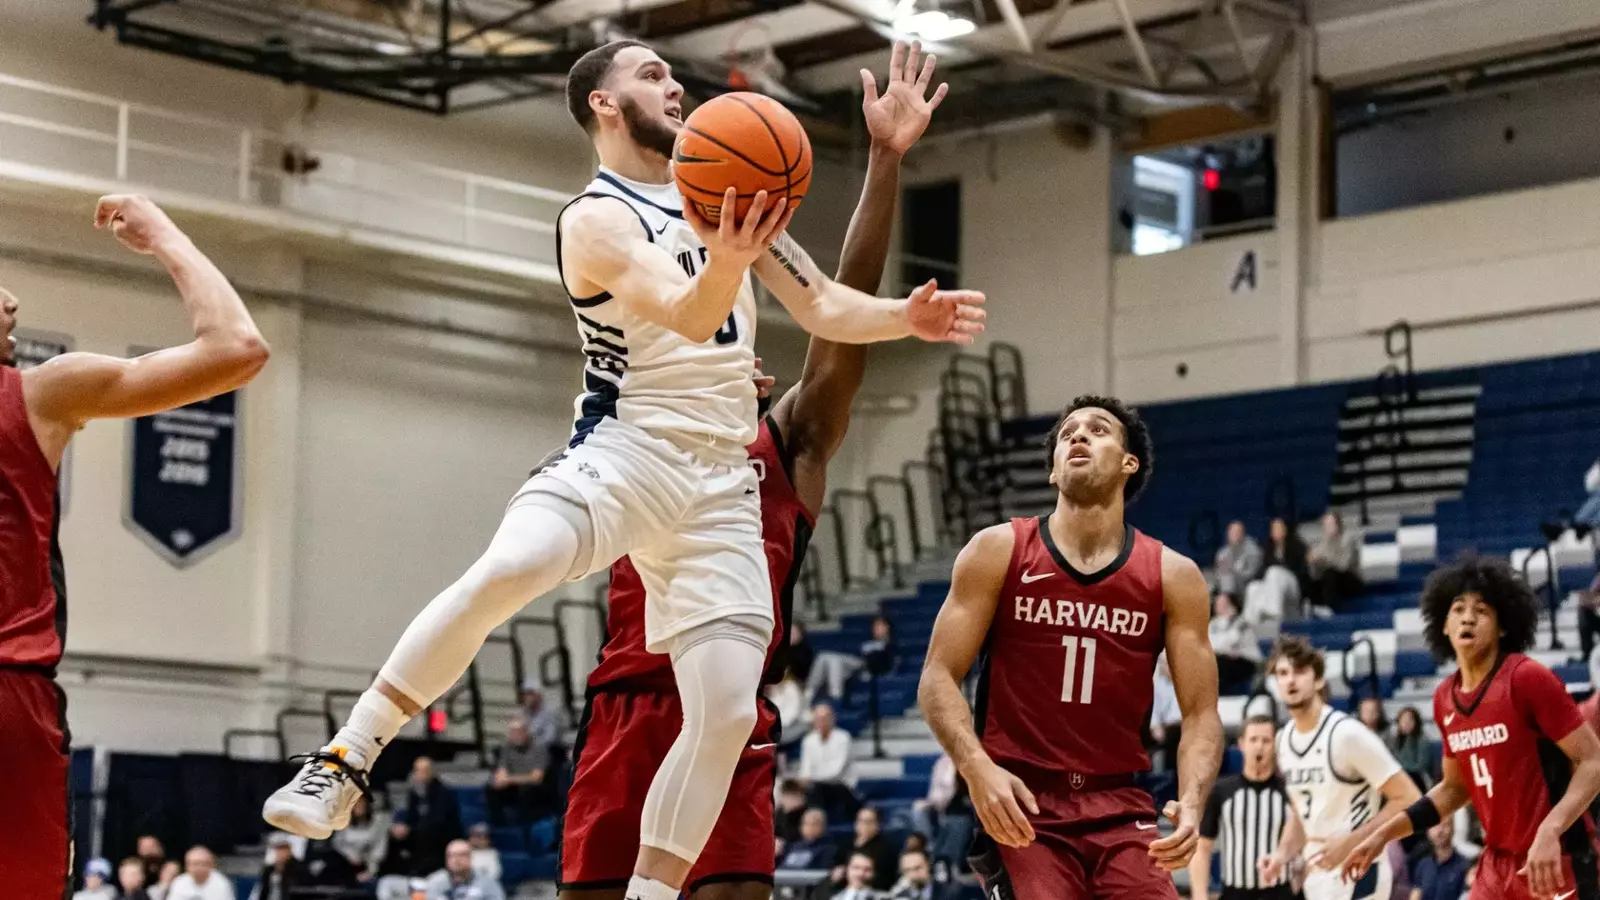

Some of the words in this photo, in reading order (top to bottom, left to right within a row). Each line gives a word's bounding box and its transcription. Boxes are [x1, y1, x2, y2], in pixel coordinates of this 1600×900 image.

[1230, 250, 1256, 292] A
[1014, 596, 1148, 637] HARVARD
[1061, 635, 1097, 705] 11
[1447, 722, 1509, 753] HARVARD
[1072, 772, 1081, 784] H
[1469, 752, 1494, 799] 4
[1301, 789, 1312, 820] 3
